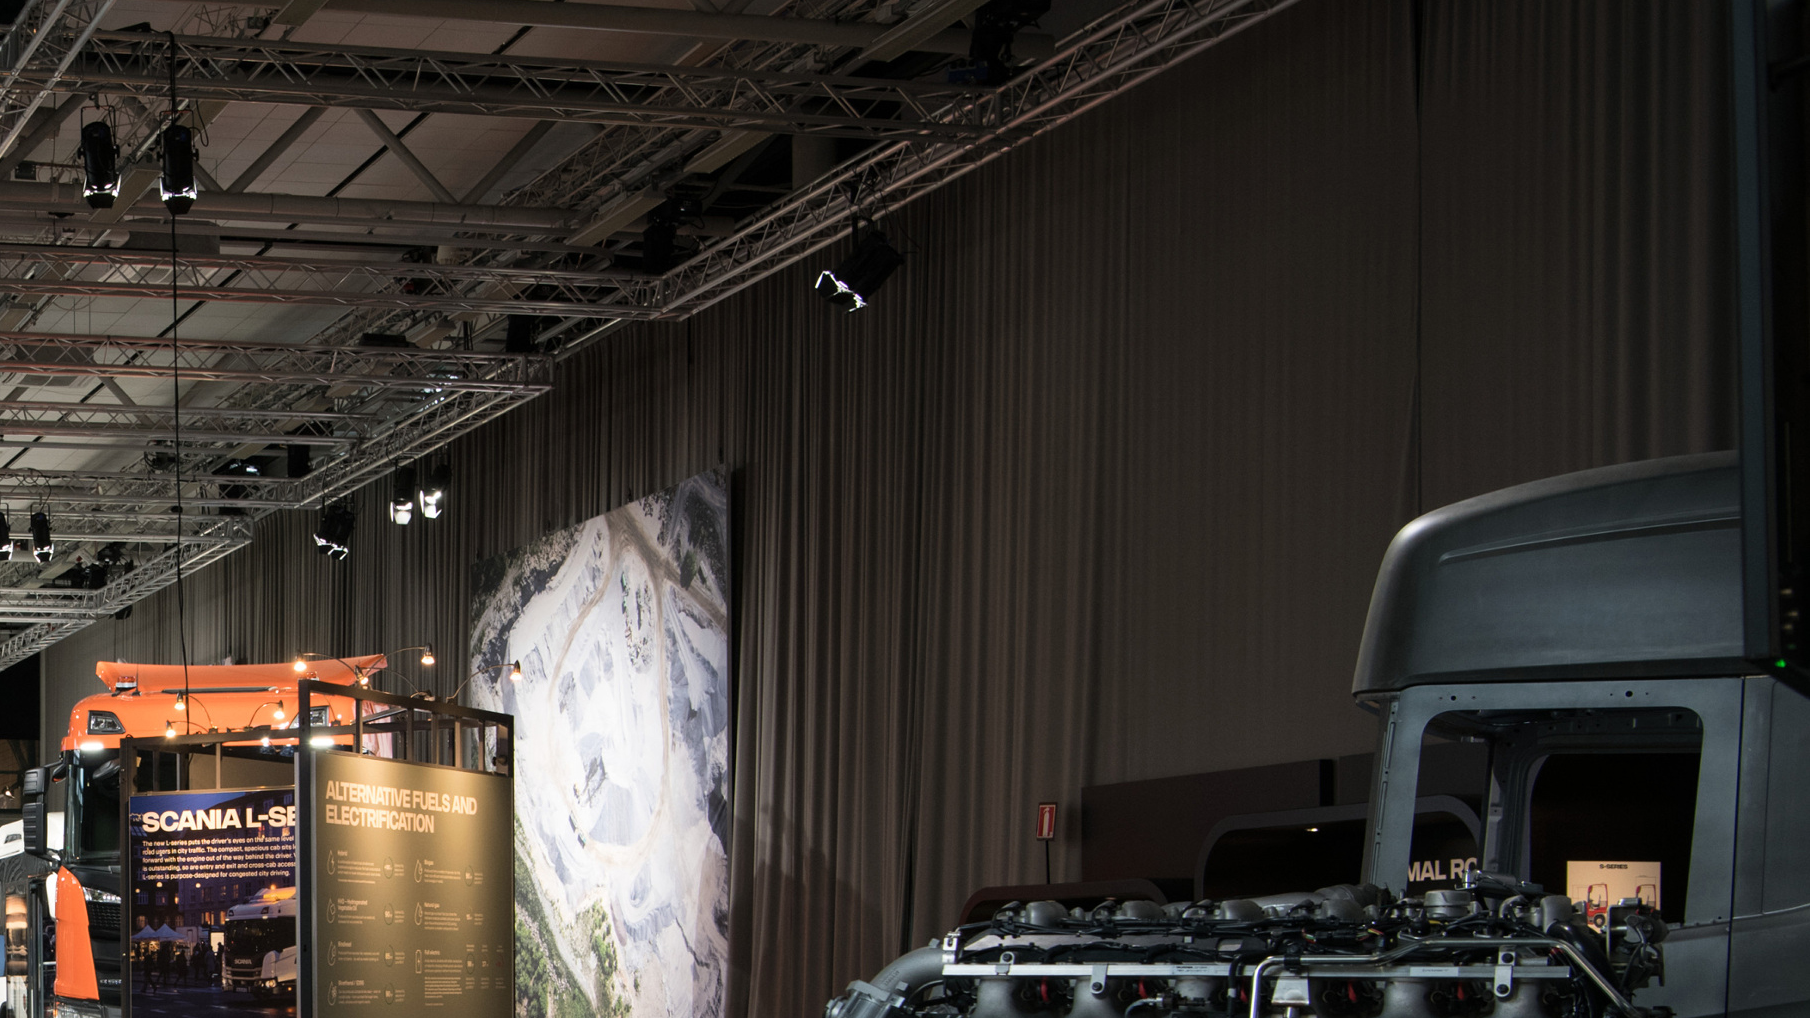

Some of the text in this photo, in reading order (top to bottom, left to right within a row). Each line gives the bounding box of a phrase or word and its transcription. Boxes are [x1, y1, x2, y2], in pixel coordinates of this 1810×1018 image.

[326, 780, 477, 815] ALTERNATIVE FUELS AND
[142, 808, 242, 832] SCANIA
[326, 804, 434, 833] ELECTRIFICATION
